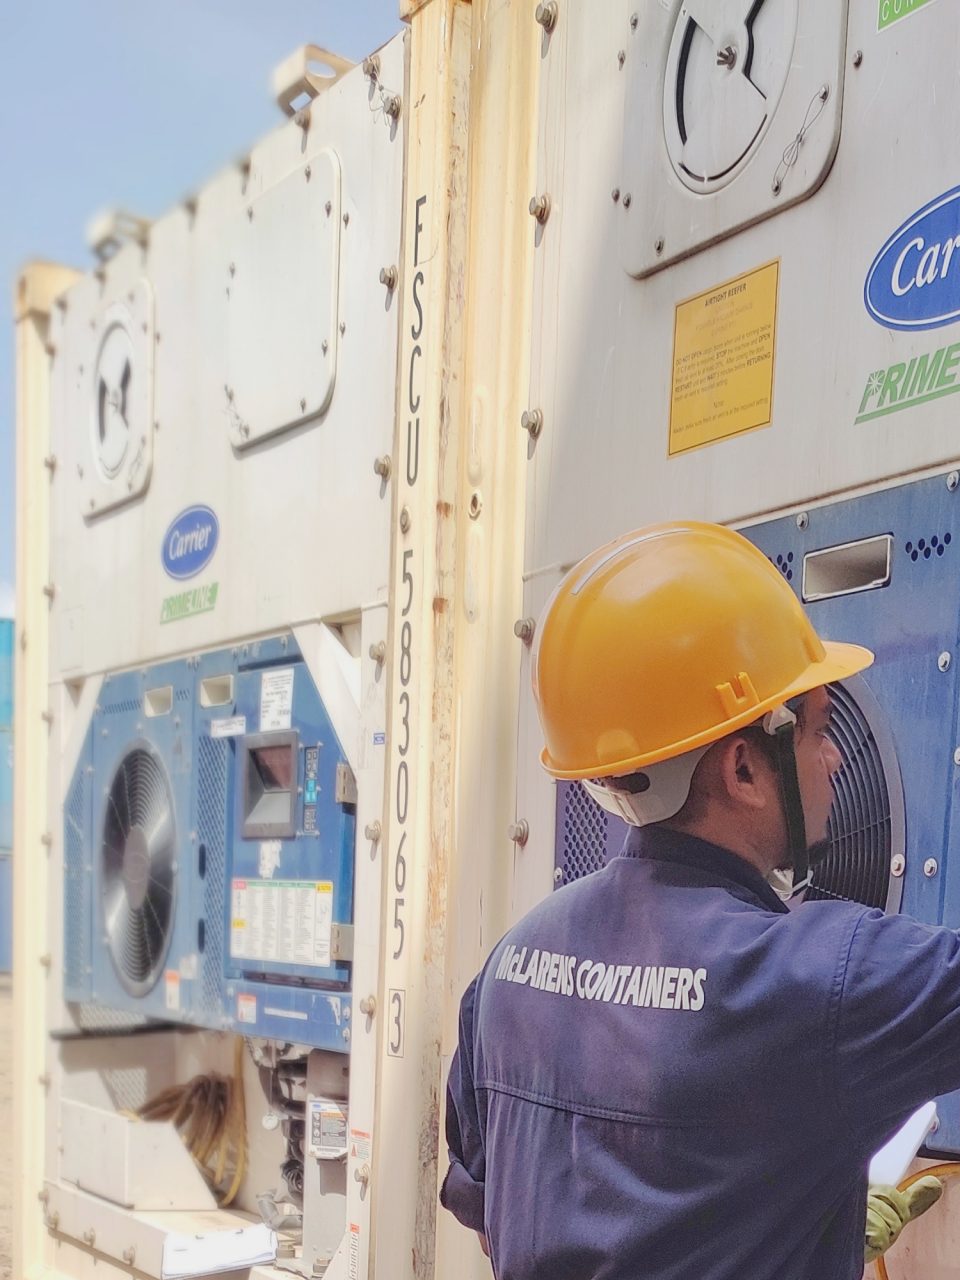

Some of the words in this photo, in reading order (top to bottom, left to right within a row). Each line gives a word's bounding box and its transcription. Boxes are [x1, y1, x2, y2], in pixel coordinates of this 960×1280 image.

[405, 193, 428, 487] FSCU
[168, 523, 212, 560] Carrier
[392, 548, 414, 961] 583065
[494, 944, 577, 997] McLARENS
[576, 959, 708, 1012] CONTAINERS
[389, 992, 402, 1054] 3
